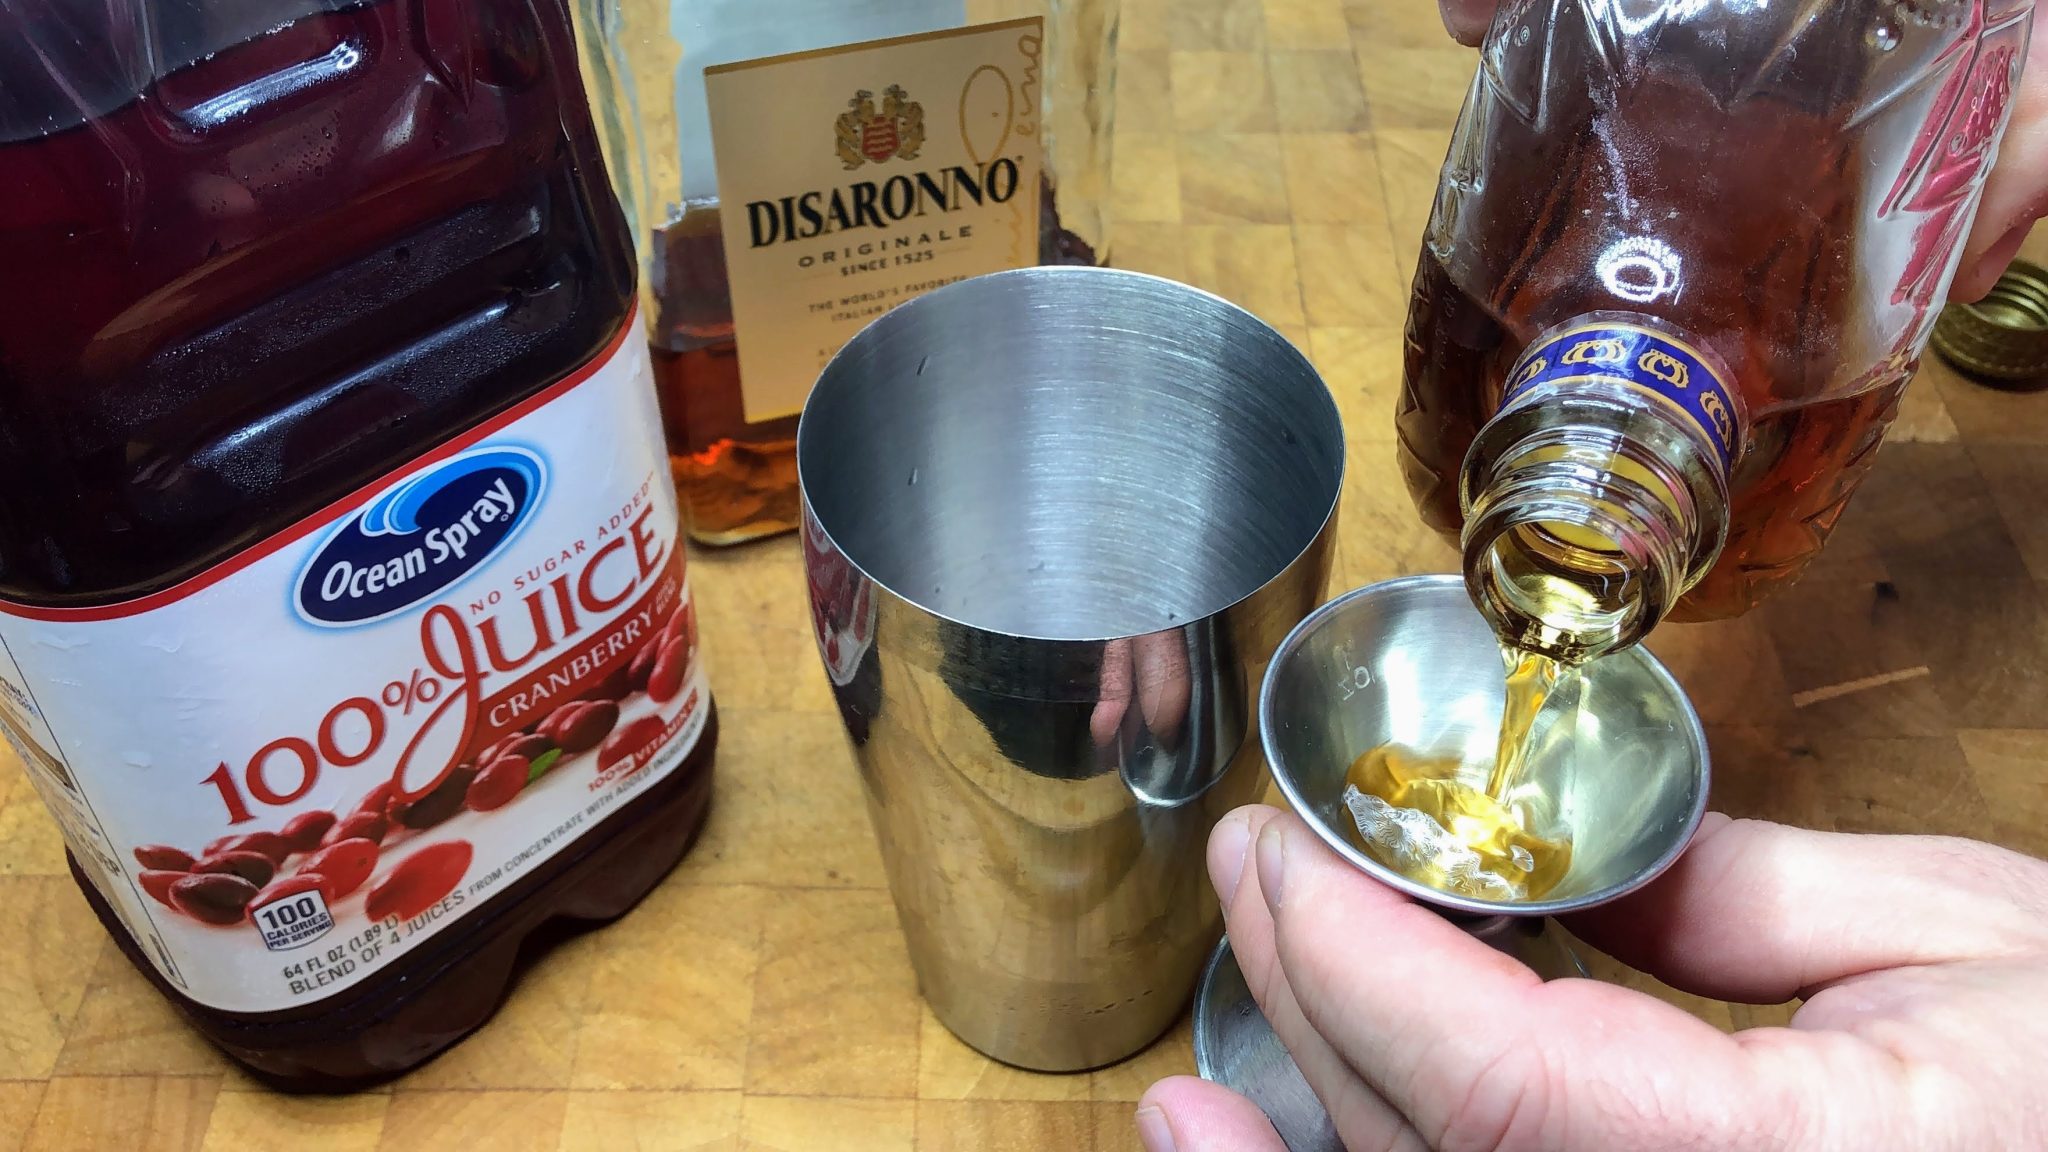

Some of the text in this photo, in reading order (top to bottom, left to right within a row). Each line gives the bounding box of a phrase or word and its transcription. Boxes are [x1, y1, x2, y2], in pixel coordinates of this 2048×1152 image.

[745, 157, 1019, 249] DISARONNO
[798, 225, 973, 268] ORIGINALE
[840, 250, 934, 277] SINCE 1525
[808, 300, 833, 313] THE
[320, 476, 516, 602] Ocean Spray
[469, 590, 502, 615] NO
[513, 538, 587, 591] SUGAR
[199, 501, 666, 826] 100% JUICE
[488, 604, 653, 728] CRANBERRY
[588, 755, 632, 792] 100%
[262, 896, 318, 929] 100
[288, 958, 357, 996] BLEND
[361, 942, 384, 964] OF
[390, 931, 401, 945] 4
[407, 889, 466, 937] JUICES
[468, 869, 503, 895] FROM
[503, 812, 584, 872] CONCENTRATE
[586, 791, 614, 816] WITH
[265, 911, 329, 942] CALORIES
[269, 920, 332, 948] PER SERVING
[283, 912, 400, 979] 64 FL OZ (1.89 L)
